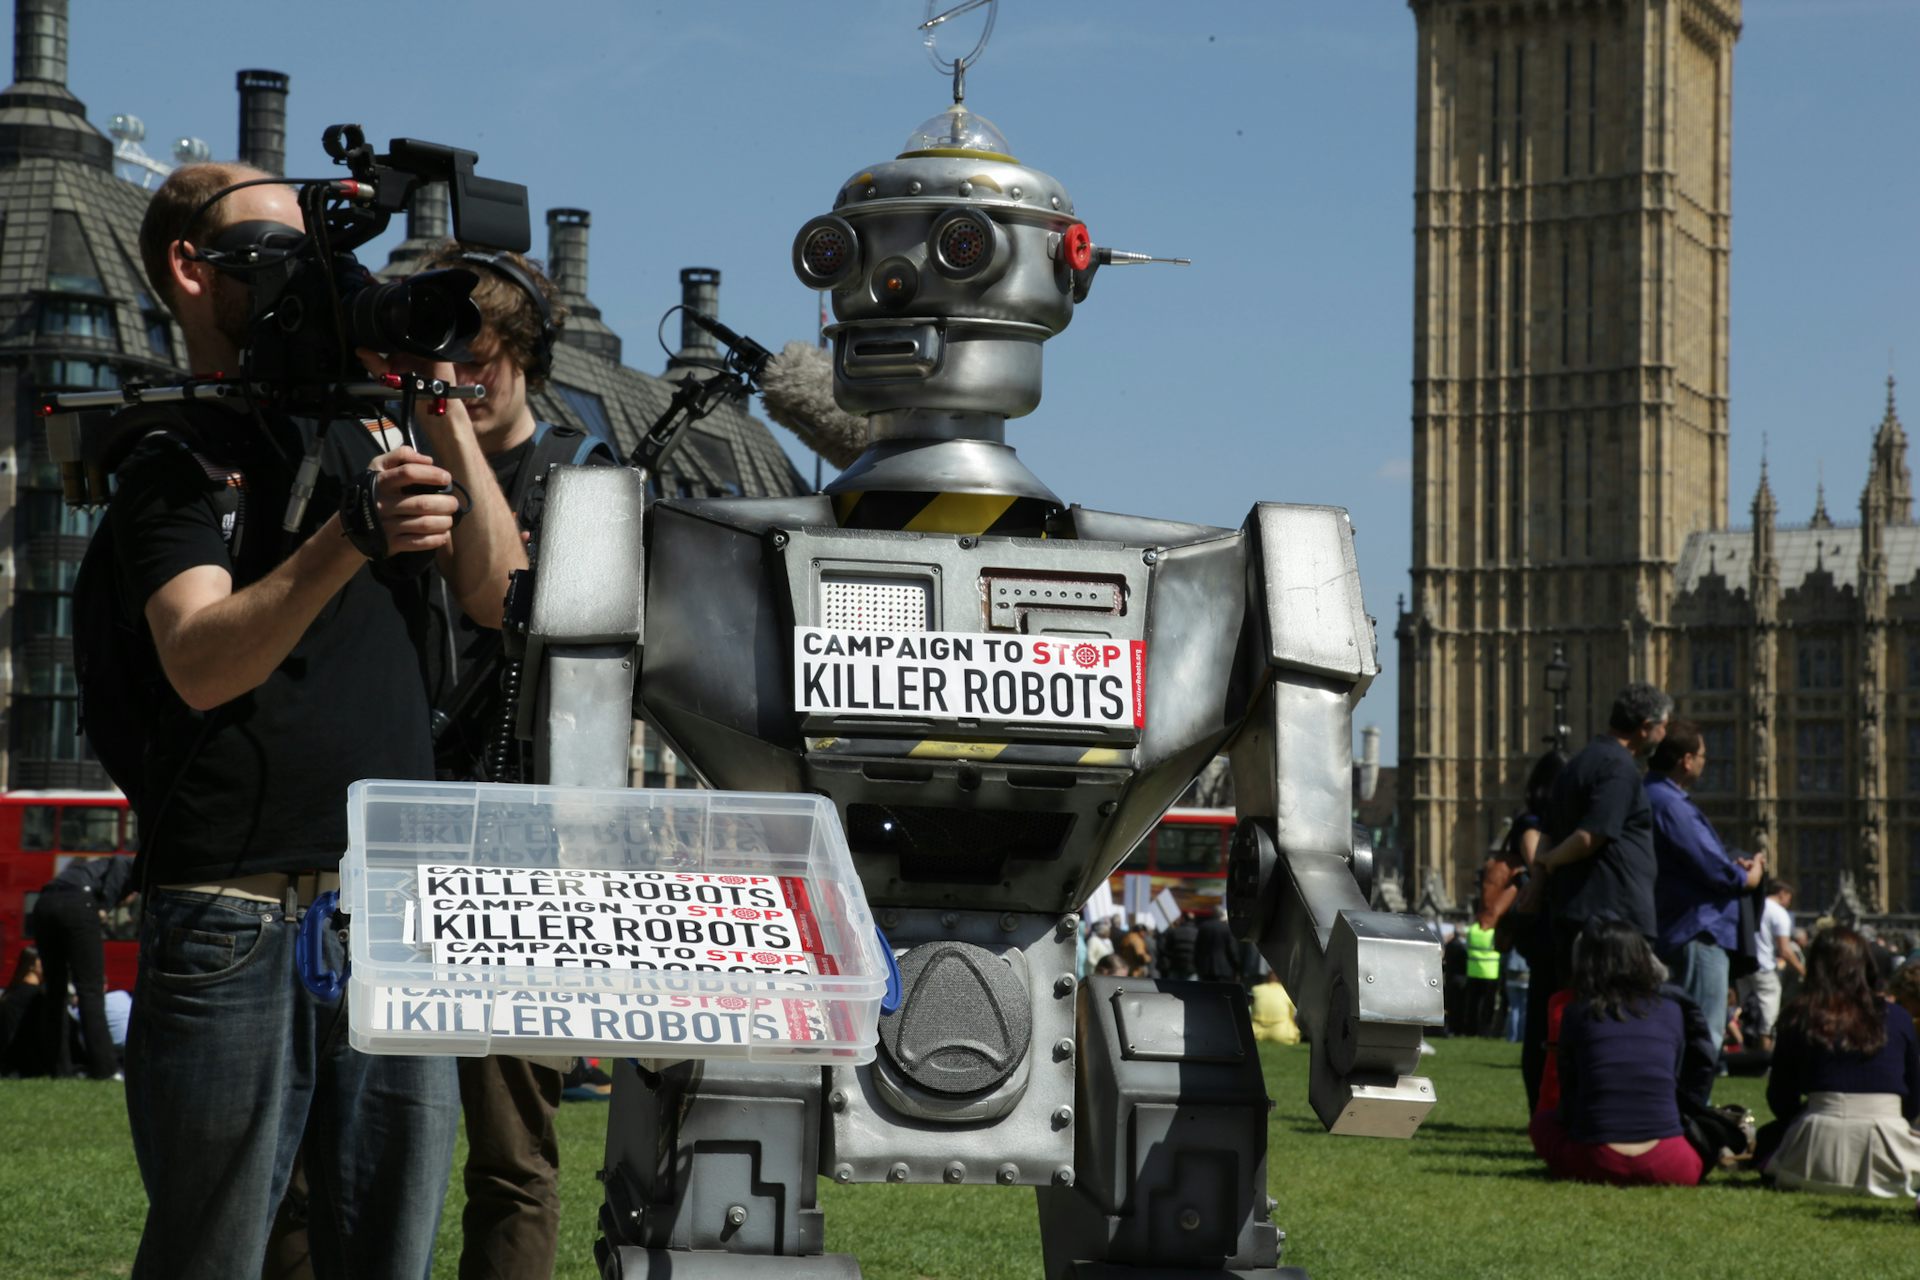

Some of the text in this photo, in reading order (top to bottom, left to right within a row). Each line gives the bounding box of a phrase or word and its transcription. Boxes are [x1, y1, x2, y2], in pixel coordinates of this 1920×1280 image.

[803, 632, 1121, 670] CAMPAIGN TO STOP
[803, 662, 1124, 720] KILLER ROBOTS
[427, 876, 587, 896] KILLER
[602, 880, 776, 908] ROBOTS
[428, 867, 770, 886] CAMPAIGN TO STOP
[432, 899, 784, 921] CAMPAIGN TO STOP
[433, 914, 597, 940] KILLER
[612, 917, 791, 949] ROBOTS
[446, 942, 805, 965] CAMPAIGN TO STOP
[402, 1000, 574, 1037] KILLER
[591, 1008, 779, 1044] ROBOTS
